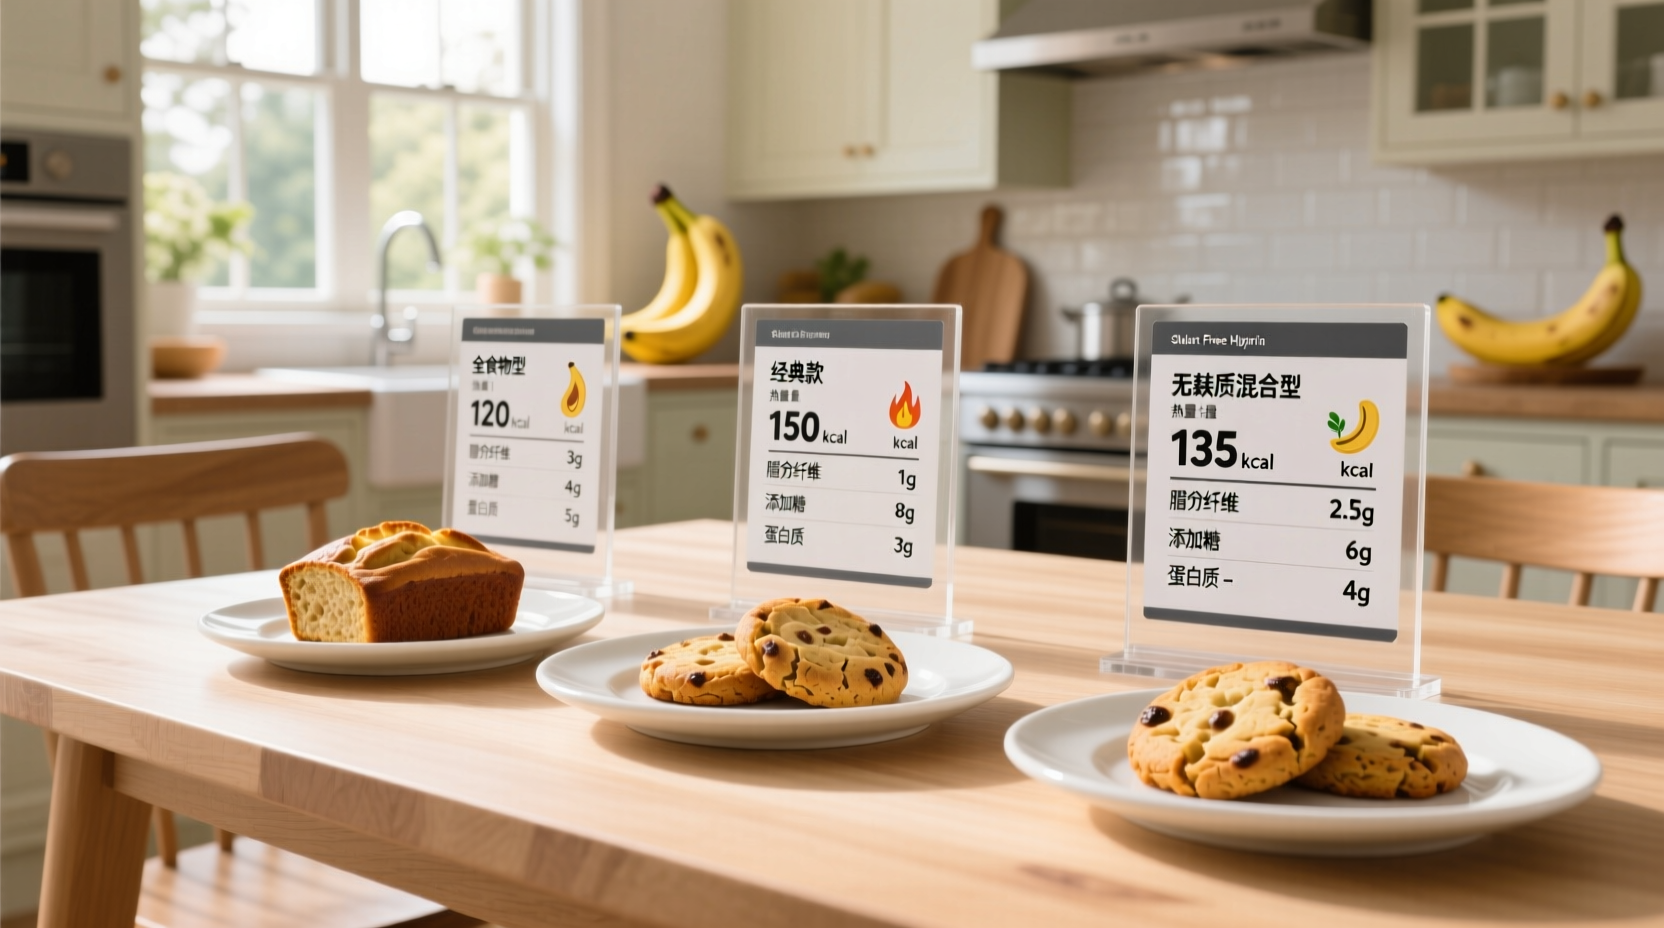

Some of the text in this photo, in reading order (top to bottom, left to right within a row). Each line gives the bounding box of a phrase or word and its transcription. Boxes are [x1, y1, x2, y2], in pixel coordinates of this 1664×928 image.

[472, 354, 526, 376] 全食物型
[769, 359, 824, 385] 经典款
[471, 399, 510, 429] 120
[563, 422, 584, 435] kcal
[769, 410, 848, 445] 150 kcal
[893, 435, 918, 450] kcal
[1171, 429, 1274, 470] 135 kcal
[566, 449, 582, 469] 3g
[1340, 461, 1374, 478] kcal
[565, 480, 581, 498] 4g
[897, 469, 917, 491] 1g
[564, 508, 580, 528] 5g
[894, 502, 915, 525] 8g
[1329, 499, 1375, 527] 2.5g
[764, 525, 914, 558] 蛋白质 3g
[1168, 527, 1372, 567] 添加糖 6g
[1167, 564, 1219, 589] 蛋白质
[1342, 579, 1371, 607] 4g
